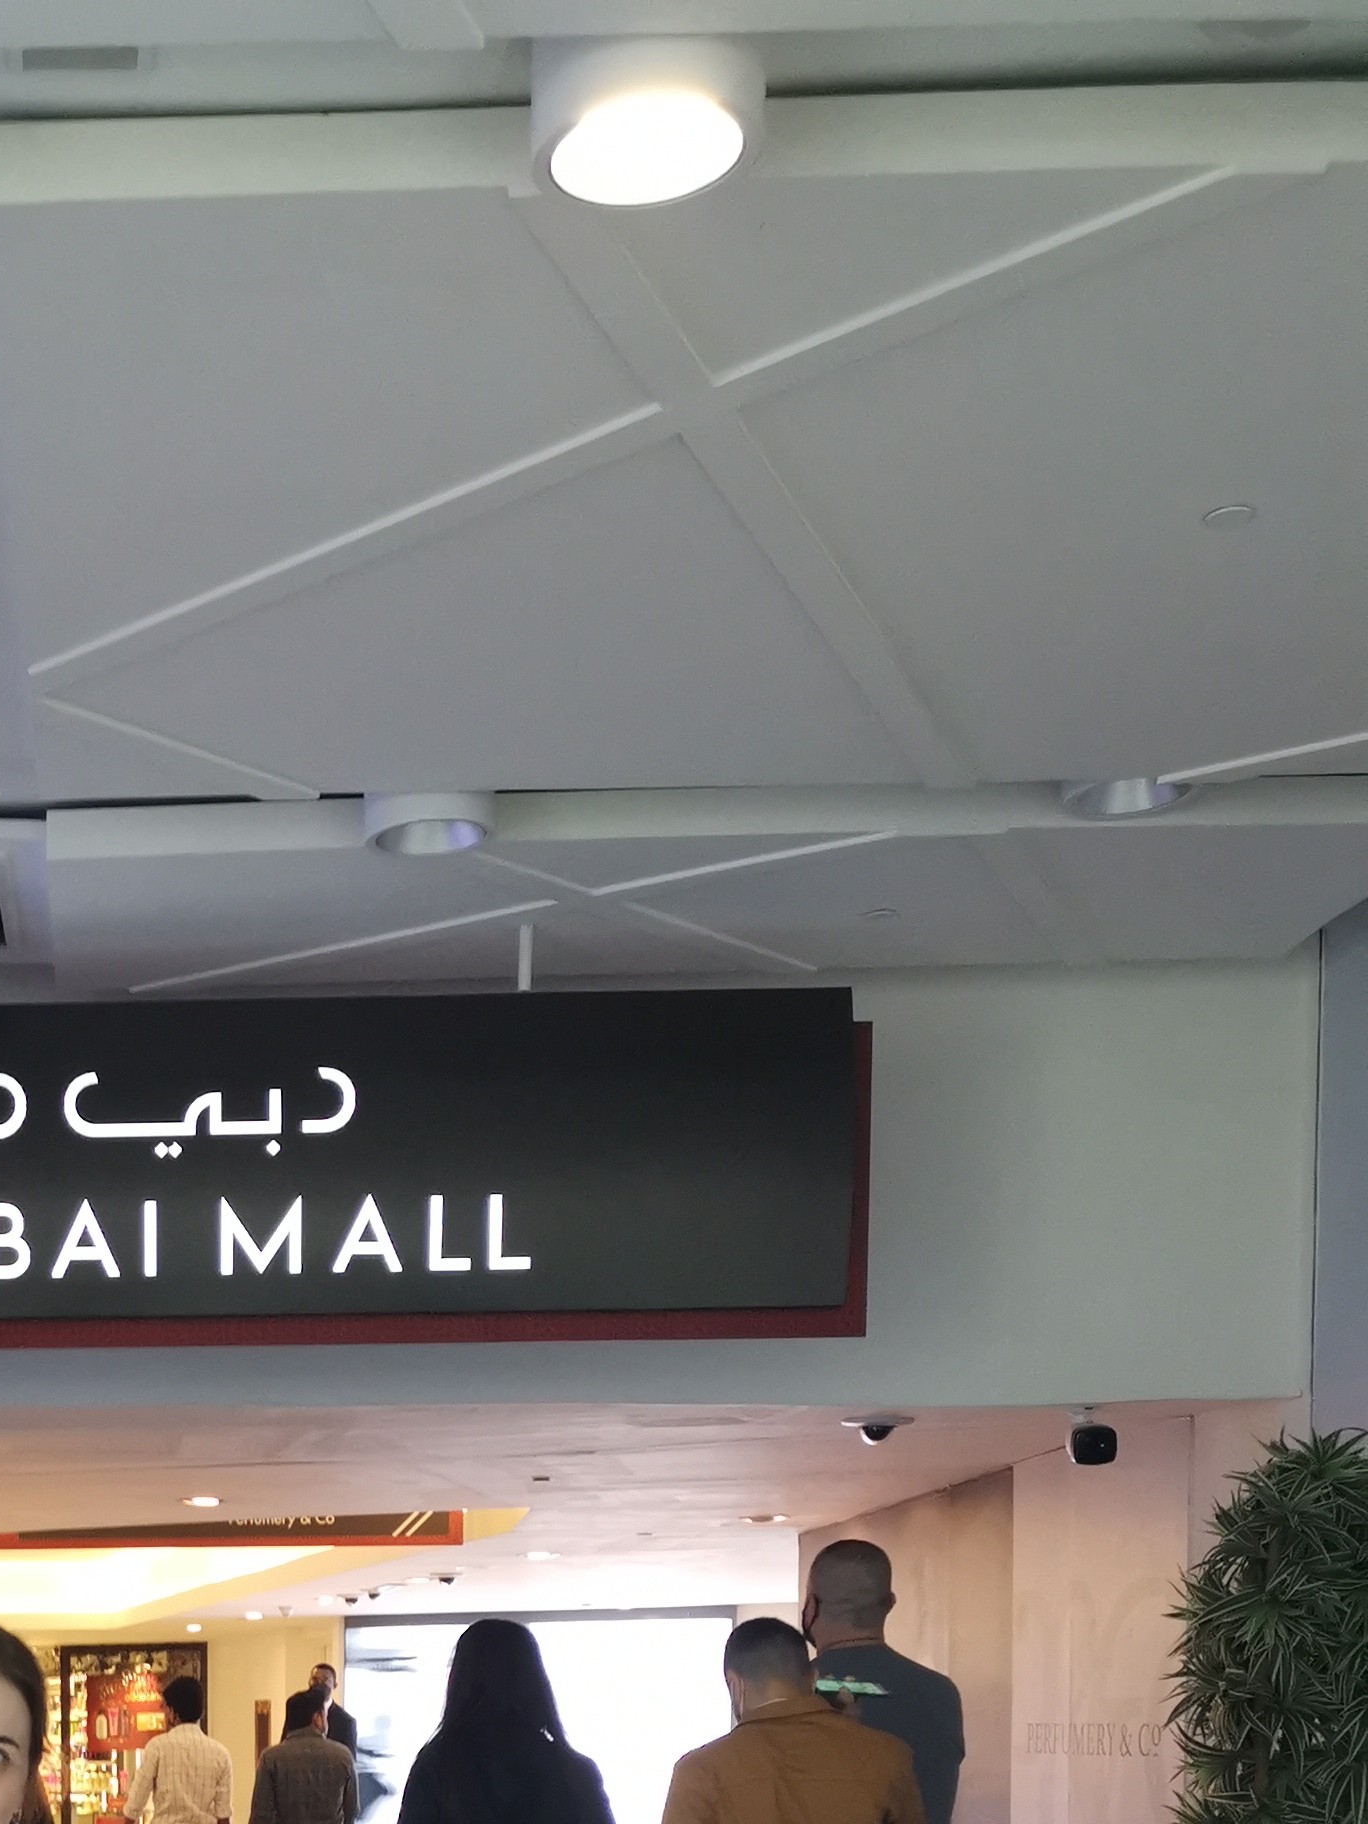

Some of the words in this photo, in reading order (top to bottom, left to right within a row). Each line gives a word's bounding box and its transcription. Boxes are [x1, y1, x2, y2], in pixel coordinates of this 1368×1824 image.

[62, 1065, 357, 1160] دبي
[218, 1192, 533, 1277] MALL
[1026, 1722, 1117, 1757] PERFUMERY
[1119, 1723, 1134, 1758] &
